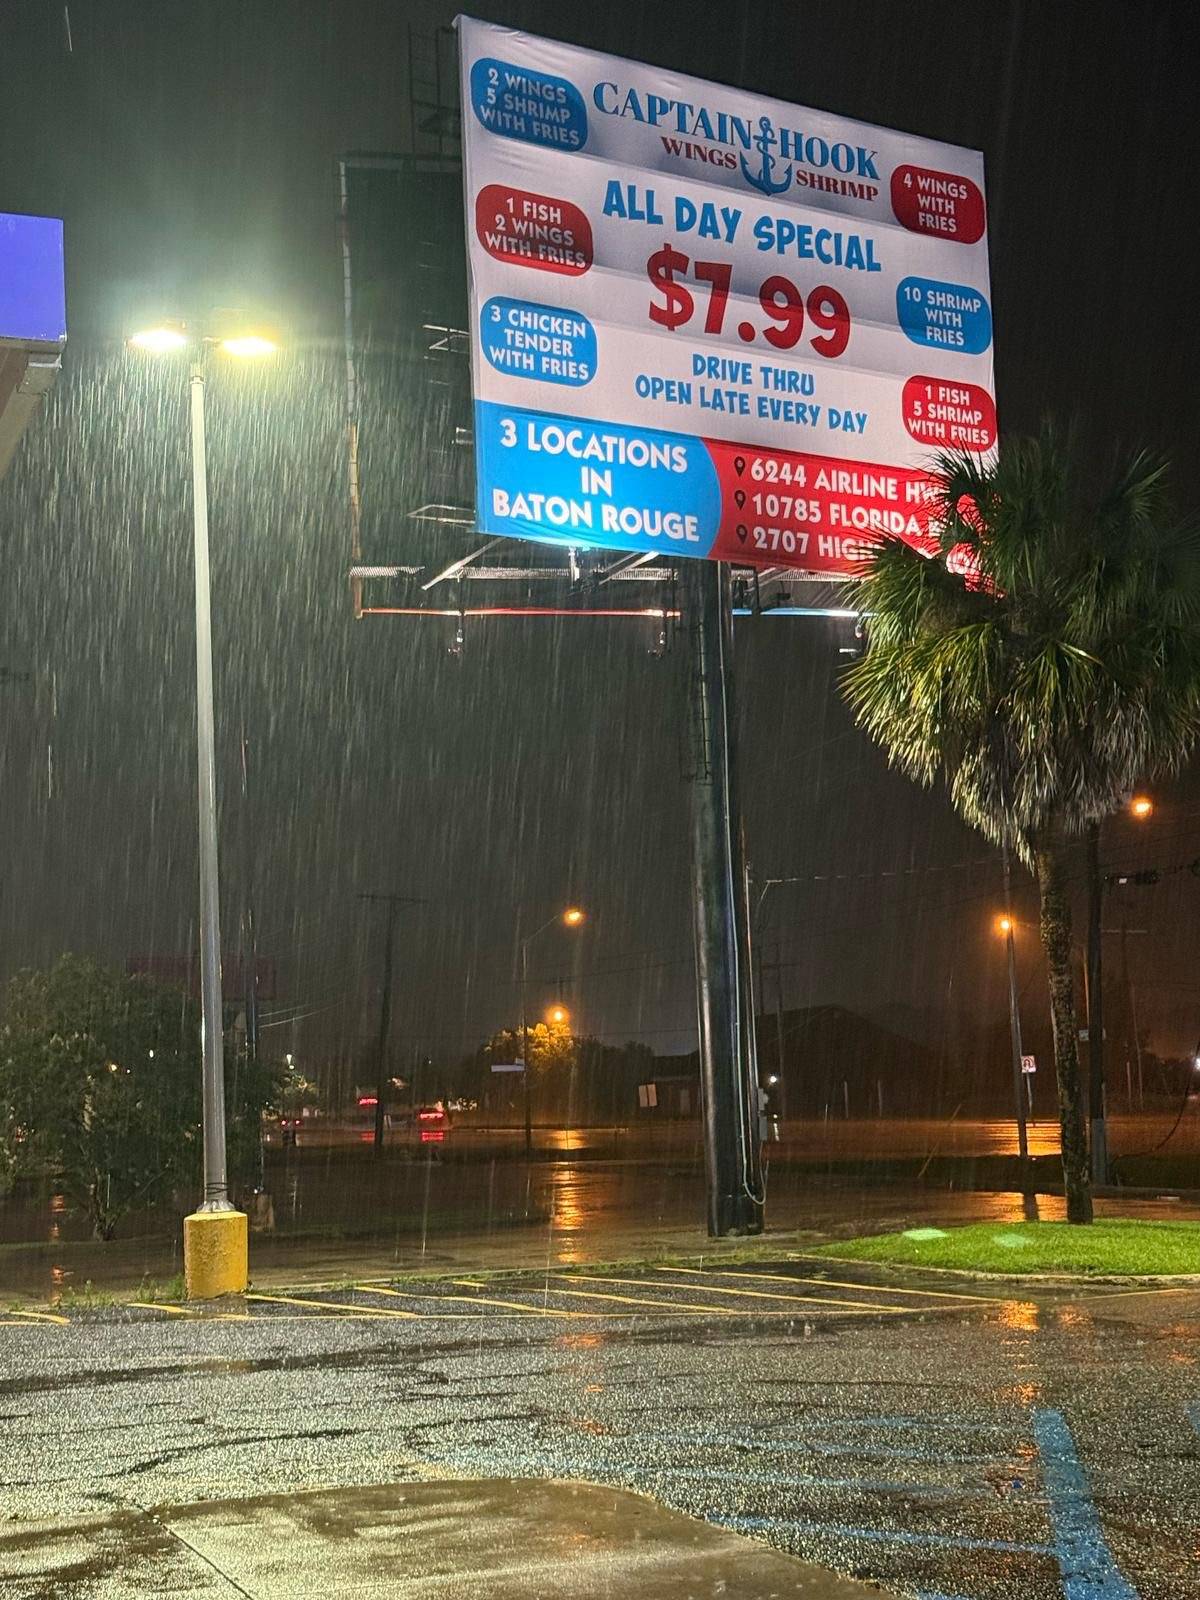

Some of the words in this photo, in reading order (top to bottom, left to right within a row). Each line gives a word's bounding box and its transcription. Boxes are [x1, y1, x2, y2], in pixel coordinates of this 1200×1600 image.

[488, 68, 499, 85] 2
[504, 73, 566, 101] WINGS
[487, 88, 496, 104] 5
[504, 94, 570, 124] SHRIMP
[480, 106, 526, 132] WITH
[532, 122, 580, 146] FRIES
[593, 82, 752, 150] CAPTAIN
[780, 128, 880, 180] HOOK
[661, 136, 737, 170] WINGS
[796, 170, 878, 201] SHRIMP
[904, 173, 912, 188] 4
[917, 175, 968, 199] WINGS
[507, 198, 514, 213] 1
[523, 201, 562, 224] FISH
[918, 194, 954, 214] WITH
[495, 215, 506, 230] 2
[512, 218, 574, 244] WINGS
[602, 180, 664, 224] ALL
[675, 196, 742, 243] DAY
[753, 216, 882, 272] SPECIAL
[918, 214, 957, 232] FRIES
[484, 232, 532, 257] WITH
[539, 246, 586, 268] FRIES
[647, 243, 850, 358] $7.99
[904, 287, 922, 302] 10
[927, 291, 982, 313] SHRIMP
[490, 305, 501, 322] 3
[508, 309, 586, 338] CHICKEN
[925, 308, 962, 327] WITH
[504, 329, 573, 357] TENDER
[926, 326, 964, 346] FRIES
[489, 346, 534, 371] WITH
[541, 357, 588, 380] FRIES
[692, 354, 752, 385] DRIVE
[760, 366, 814, 396] THRU
[635, 374, 692, 404] OPEN
[700, 387, 749, 415] LATE
[758, 396, 820, 430] EVERY
[828, 408, 868, 434] DAY
[925, 386, 932, 400] 1
[939, 387, 970, 406] FISH
[913, 402, 922, 416] 5
[928, 404, 982, 425] SHRIMP
[500, 420, 517, 448] 3
[527, 423, 687, 473] LOCATIONS
[908, 419, 944, 438] WITH
[951, 426, 989, 445] FRIES
[581, 467, 612, 497] IN
[750, 458, 806, 487] 6244
[814, 468, 898, 501] AIRLINE
[493, 488, 592, 528] BATON
[602, 504, 700, 542] ROUGE
[753, 492, 821, 523] 10785
[830, 503, 922, 536] FLORIDA
[753, 526, 809, 554] 2707
